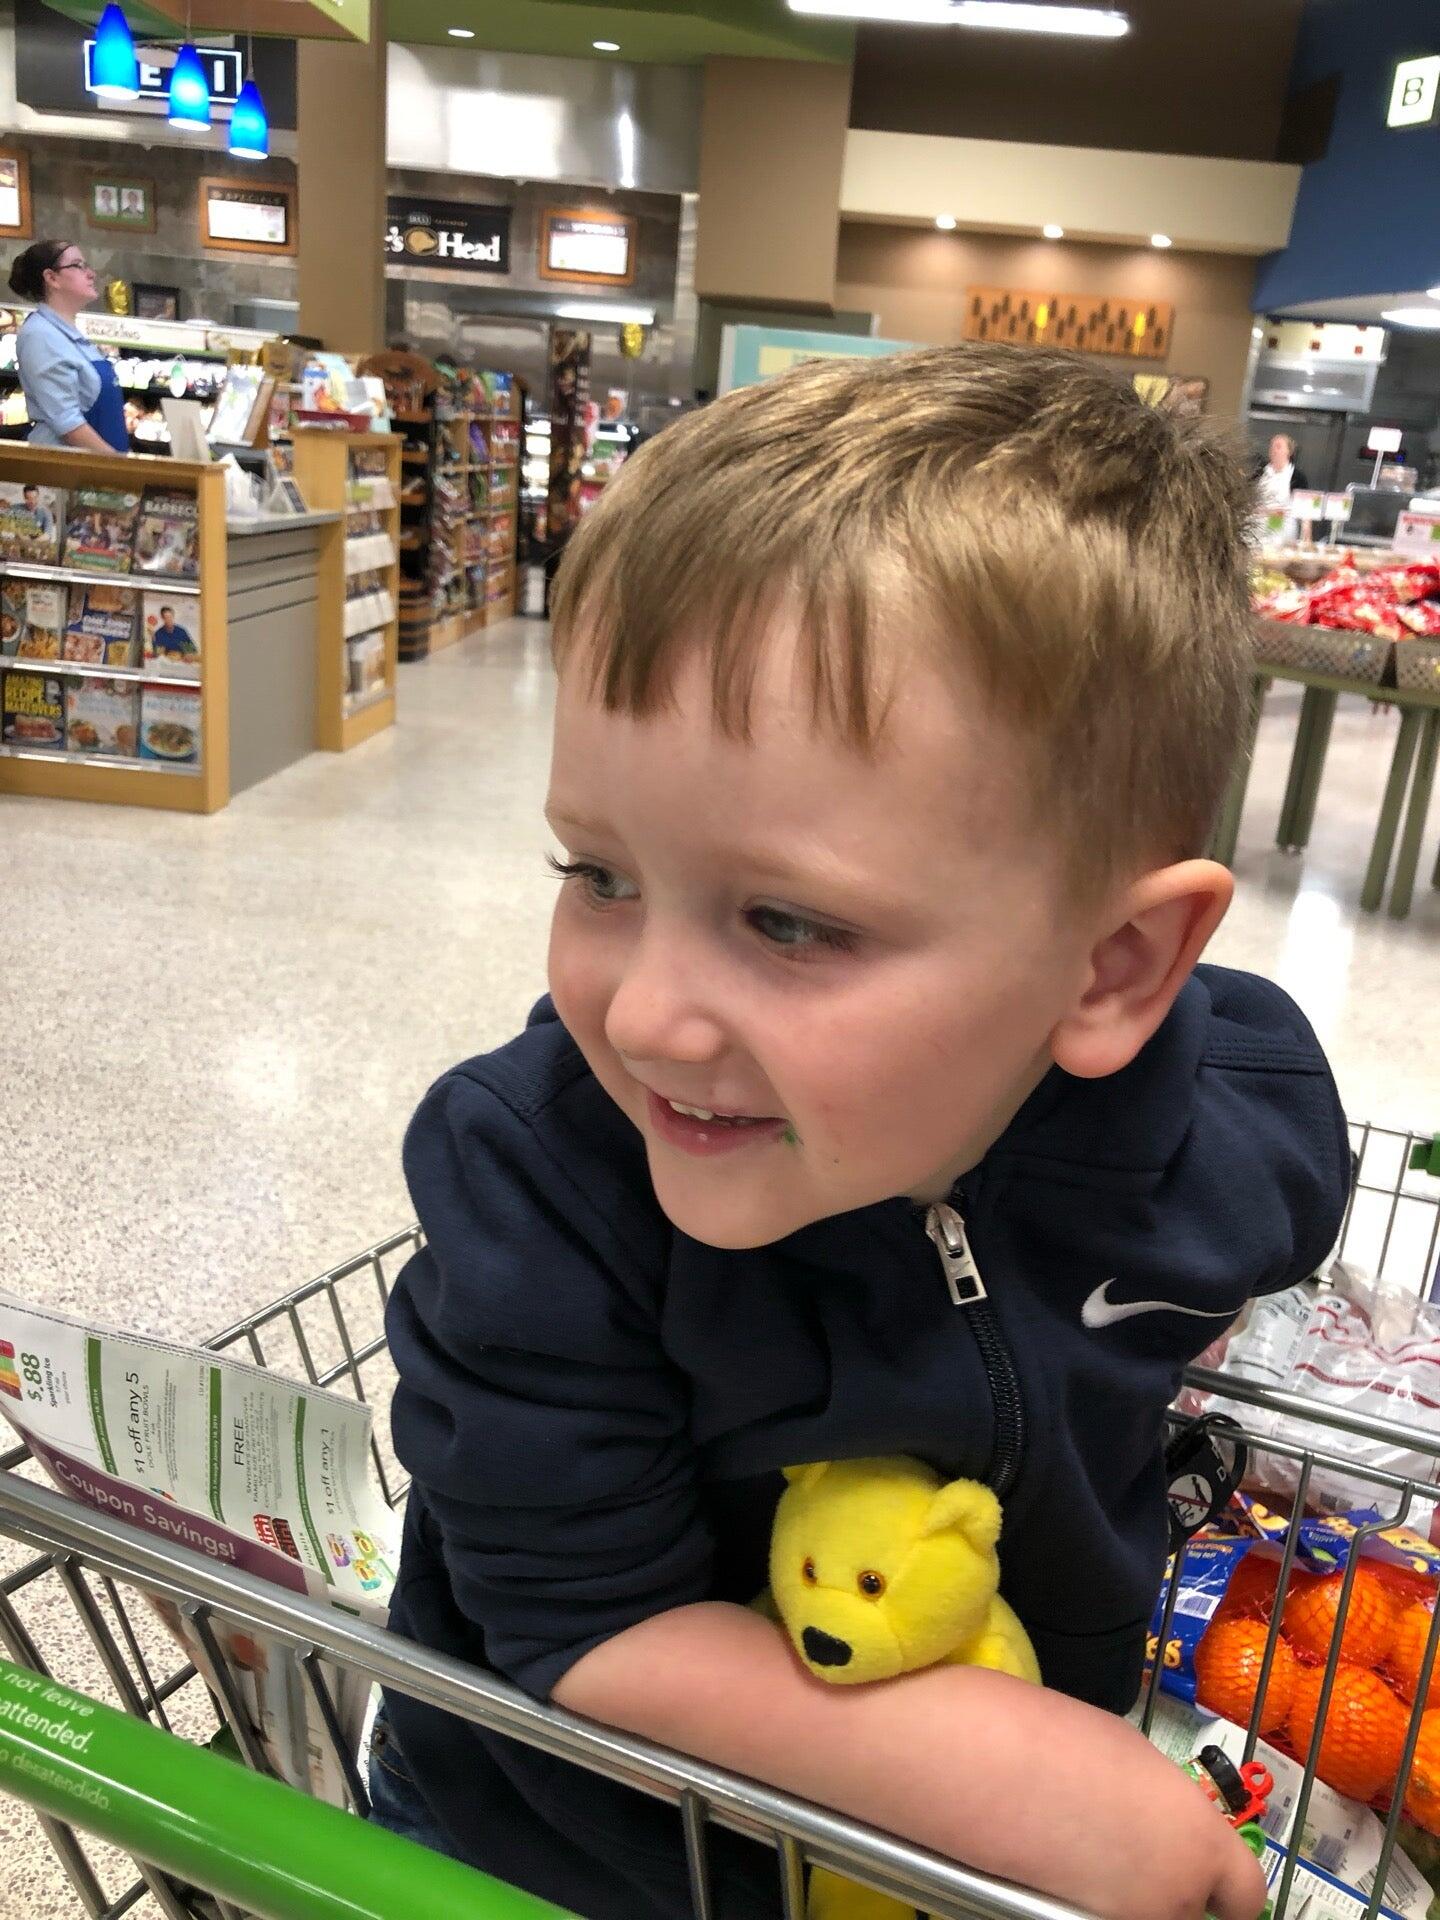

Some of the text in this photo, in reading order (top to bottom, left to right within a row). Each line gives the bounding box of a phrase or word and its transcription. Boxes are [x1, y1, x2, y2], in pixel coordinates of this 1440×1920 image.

[1402, 77, 1424, 106] B
[438, 231, 501, 262] Head
[21, 1352, 44, 1401] $.88
[45, 1370, 58, 1408] Sparkling
[142, 1384, 150, 1416] BOWLS
[126, 1371, 145, 1474] $1 off any 5
[234, 1416, 244, 1465] FREE
[321, 1474, 332, 1497] off
[55, 1460, 136, 1517] Coupon
[143, 1504, 236, 1560] Savings!
[4, 1672, 95, 1717] not leave
